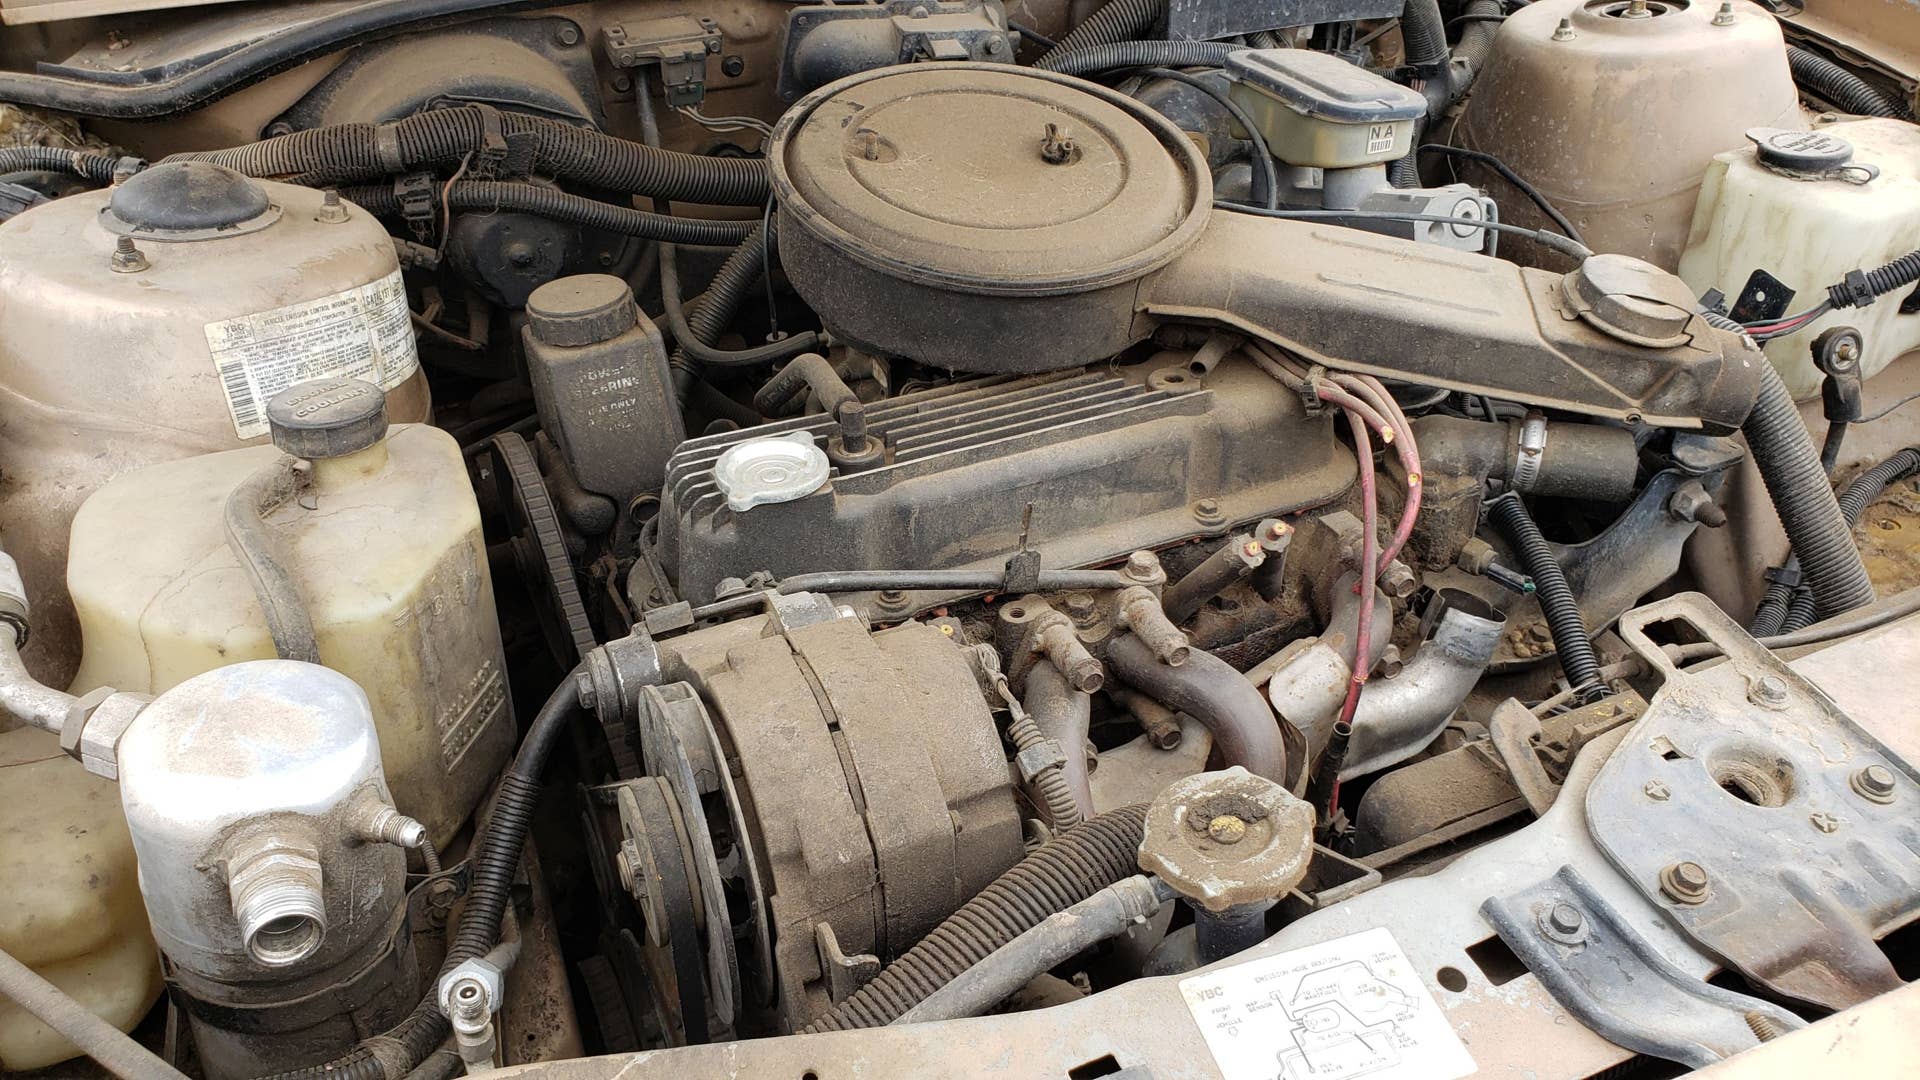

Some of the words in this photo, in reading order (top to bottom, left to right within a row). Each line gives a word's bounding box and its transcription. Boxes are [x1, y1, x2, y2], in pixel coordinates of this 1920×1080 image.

[309, 304, 330, 315] CONTROL
[296, 387, 369, 417] COOLANT
[1196, 986, 1224, 1001] YBC
